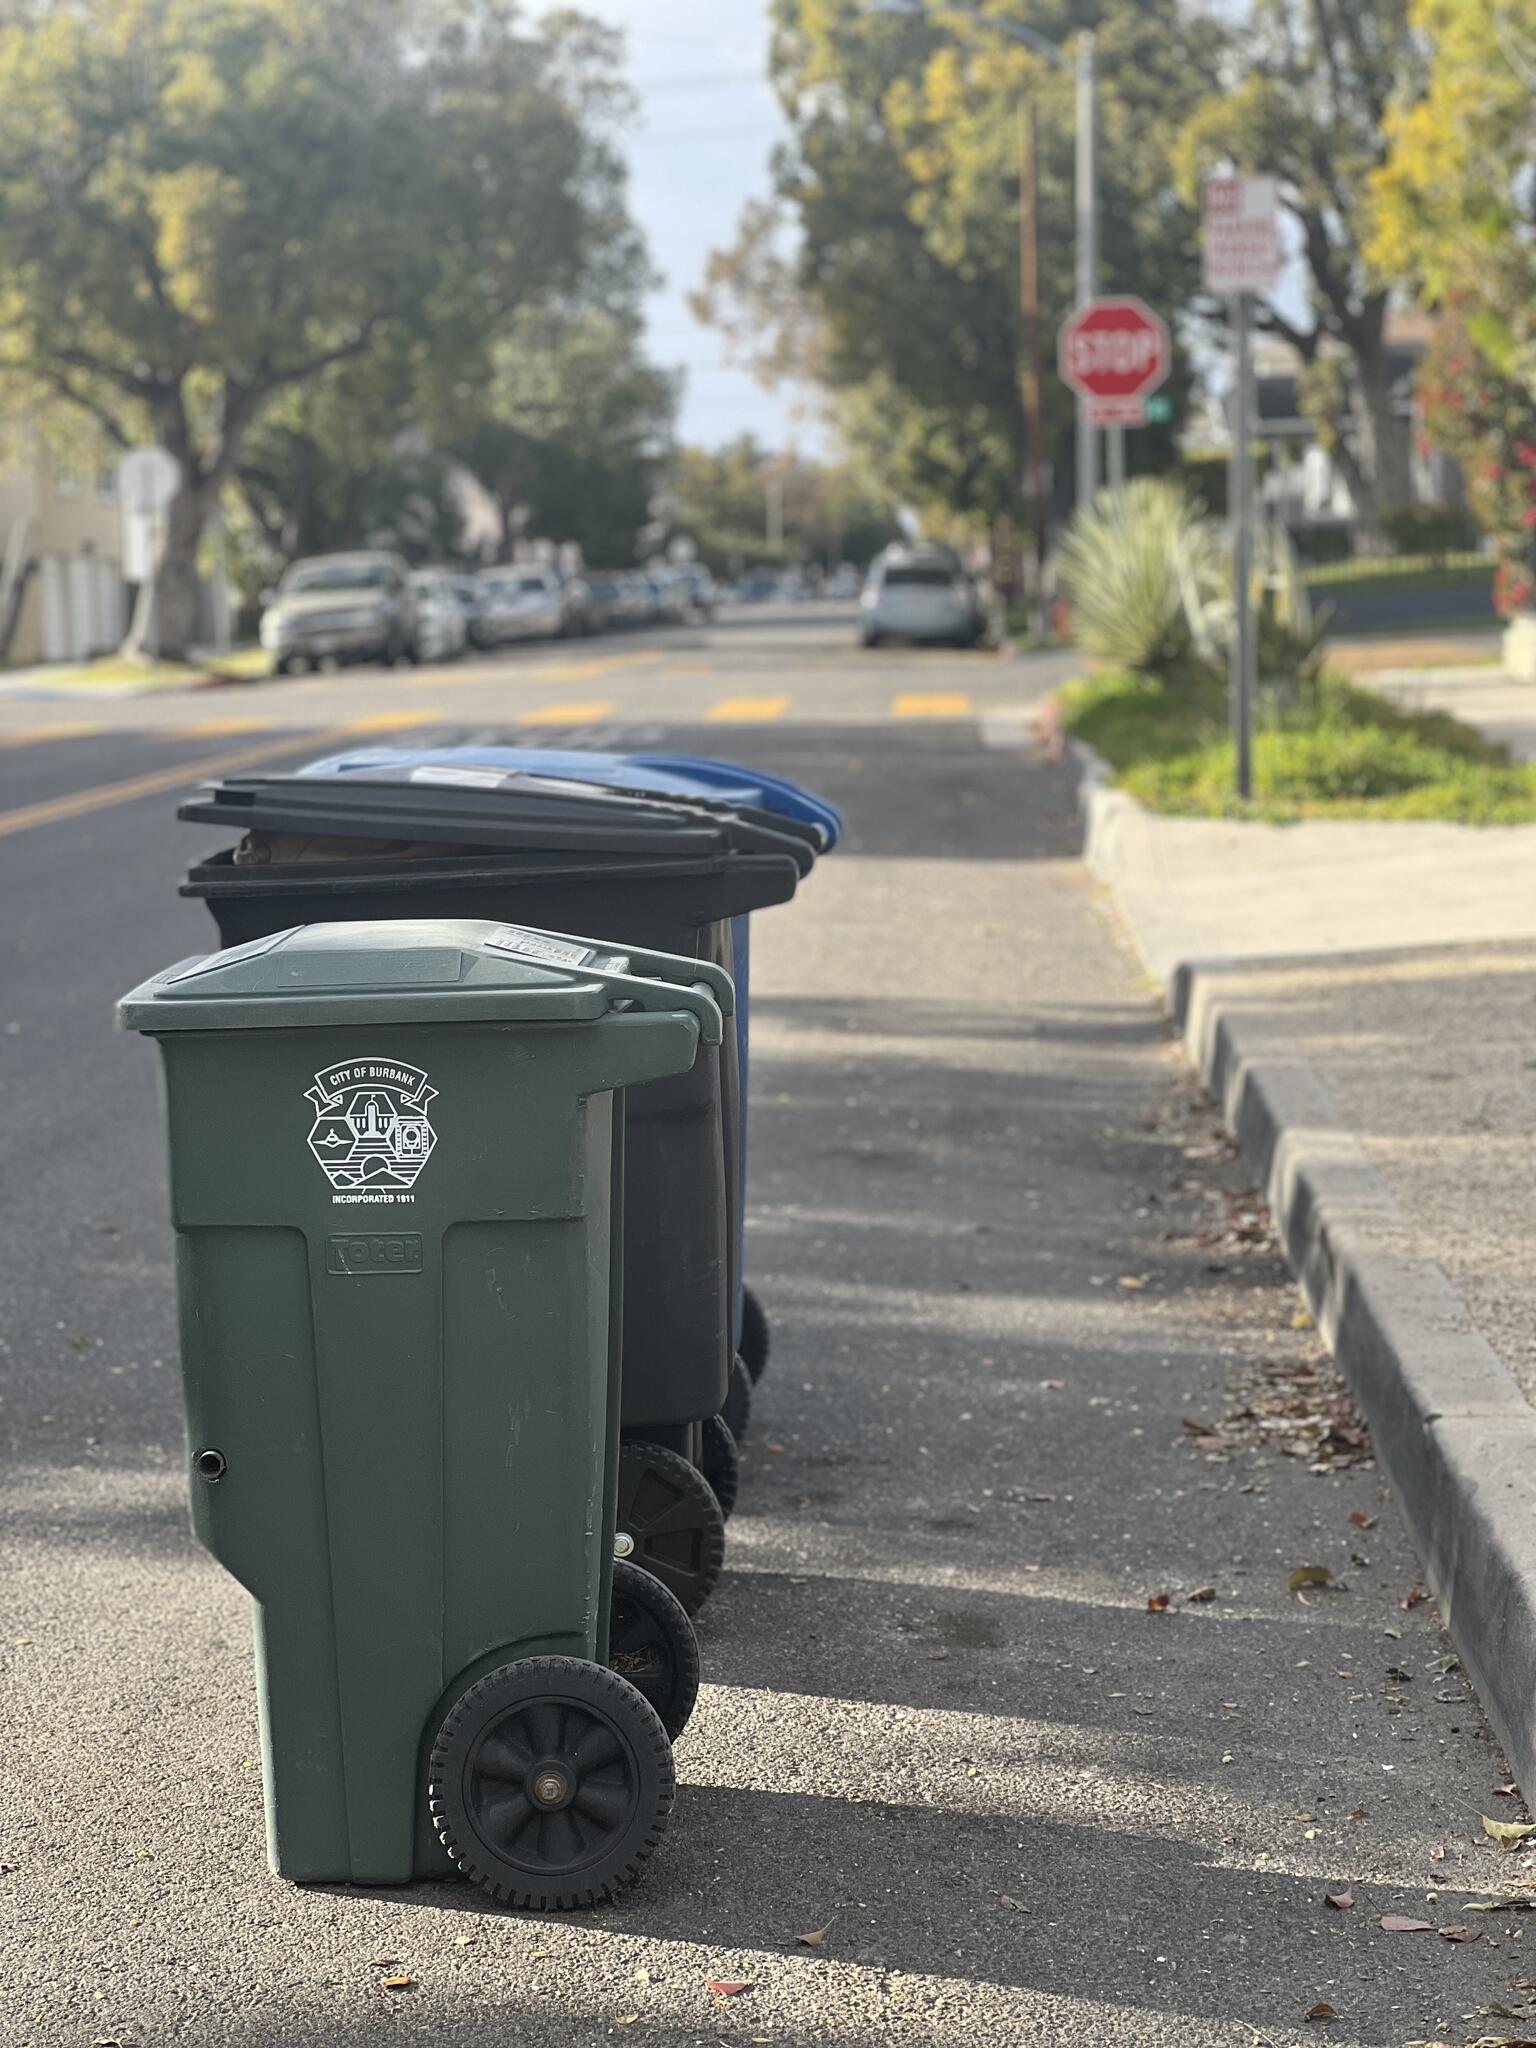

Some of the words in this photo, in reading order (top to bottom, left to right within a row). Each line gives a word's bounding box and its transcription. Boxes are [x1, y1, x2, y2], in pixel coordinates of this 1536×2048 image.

[1071, 328, 1157, 376] STOP
[329, 1069, 351, 1086] CITY
[353, 1067, 367, 1079] OF
[369, 1066, 416, 1087] BURBANK
[332, 1194, 395, 1204] INCORPORATED
